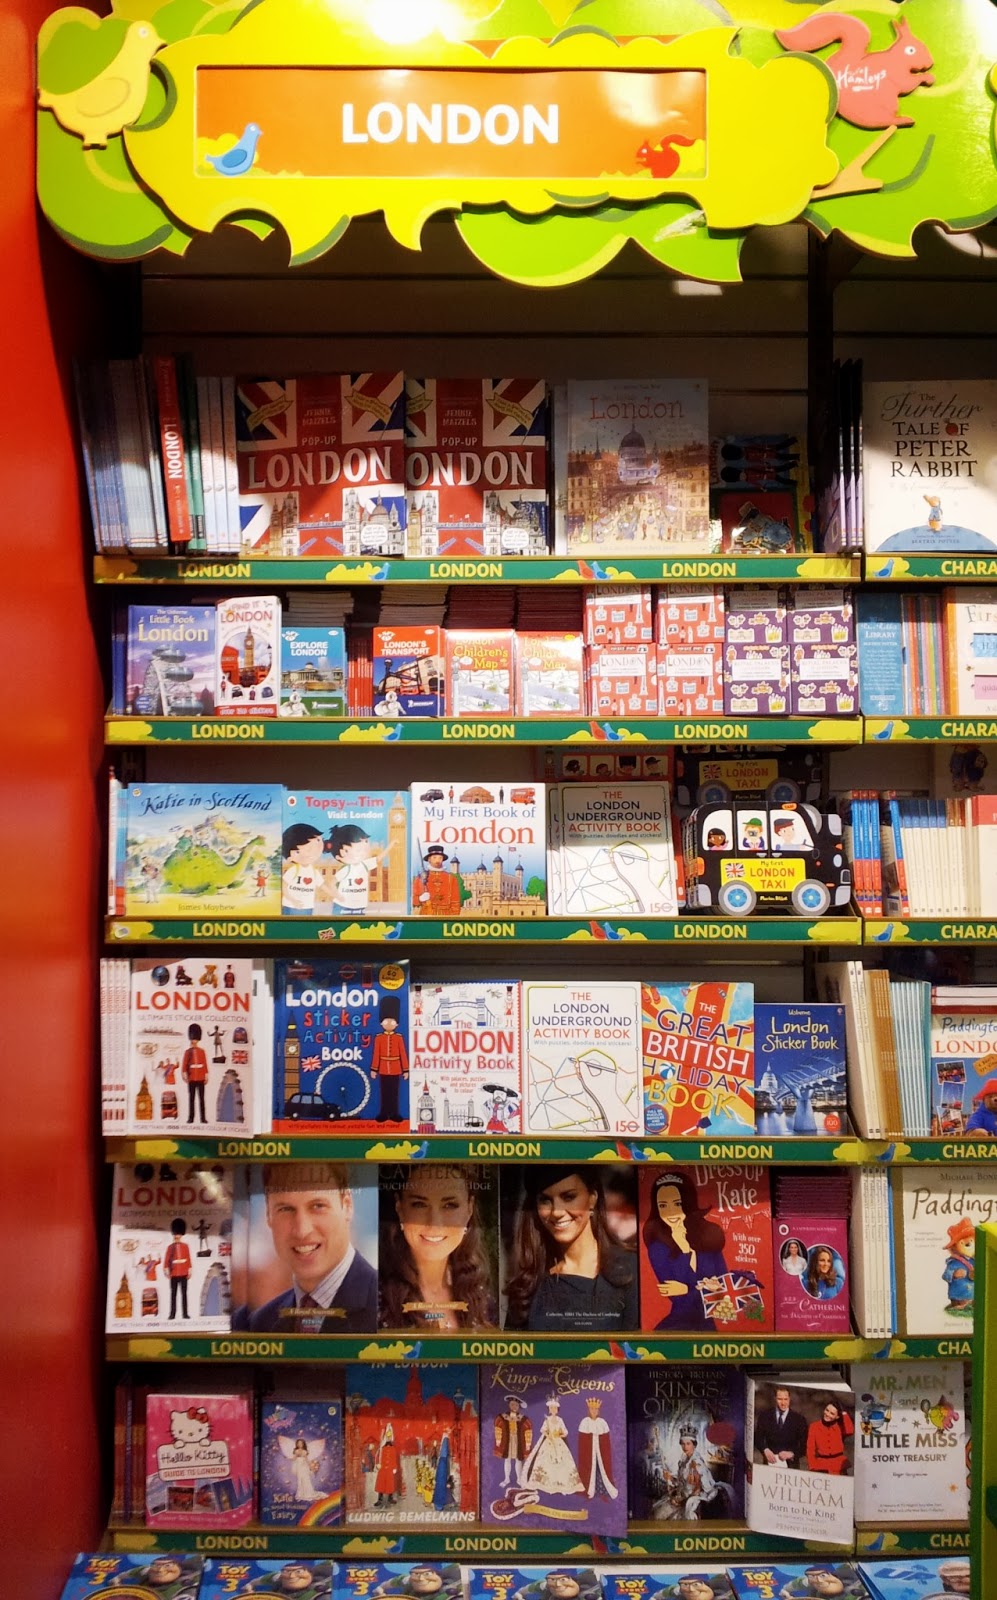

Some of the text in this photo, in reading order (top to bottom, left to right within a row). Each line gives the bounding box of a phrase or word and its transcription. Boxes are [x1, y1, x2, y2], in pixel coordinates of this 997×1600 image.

[837, 64, 887, 91] Hamleys
[342, 102, 559, 145] LONDON
[919, 393, 936, 401] The
[590, 395, 685, 420] London
[881, 391, 983, 422] Further
[892, 421, 970, 437] TALE OF
[302, 436, 337, 446] POP-UP
[442, 437, 478, 446] POP-UP
[163, 423, 183, 480] LONDON
[894, 440, 972, 457] PETER
[248, 446, 392, 489] LONDON
[406, 451, 534, 487] ONDON
[891, 460, 978, 478] RABBIT
[178, 563, 251, 578] LONDON
[429, 563, 503, 578] LONDON
[662, 562, 737, 577] LONDON
[149, 615, 195, 624] Little Book
[220, 611, 273, 623] LONDON
[138, 624, 209, 642] London
[864, 631, 896, 639] LIBRARY
[290, 641, 329, 649] EXPLORE
[381, 647, 430, 655] TRANSPORT
[383, 640, 427, 649] LONDON'S
[291, 648, 327, 656] LONDON
[453, 646, 509, 658] Children's
[474, 658, 498, 670] Map
[543, 660, 567, 670] Map
[192, 724, 265, 739] LONDON
[442, 724, 515, 738] LONDON
[674, 724, 748, 739] LONDON
[726, 768, 769, 777] LONDON
[735, 780, 760, 788] TAXI
[602, 791, 623, 799] THE
[141, 791, 273, 817] Katie in Scotland
[305, 795, 384, 810] Topsy Tim
[586, 801, 640, 810] LONDON
[327, 810, 383, 819] Visit London
[424, 806, 537, 821] My First Book of
[566, 812, 662, 821] UNDERGROUND
[424, 819, 535, 845] London
[568, 823, 661, 832] ACTIVITY BOOK
[750, 868, 795, 877] LONDON
[289, 885, 314, 893] LONDON
[760, 880, 787, 889] TAXI
[178, 903, 236, 912] James Mayhew
[193, 922, 266, 937] LONDON
[443, 922, 515, 937] LONDON
[673, 924, 747, 939] LONDON
[136, 991, 250, 1013] LONDON
[286, 982, 378, 1008] London
[571, 992, 592, 1001] THE
[553, 1003, 610, 1013] LONDON
[699, 1001, 718, 1014] THE
[454, 1020, 472, 1029] The
[532, 1016, 632, 1027] UNDERGROUND
[657, 1008, 750, 1047] GREAT
[771, 1016, 829, 1034] London
[303, 1029, 372, 1048] Activity
[533, 1028, 630, 1039] ACTIVITY BOOK
[413, 1030, 514, 1054] LONDON
[762, 1034, 839, 1053] Sticker Book
[646, 1031, 750, 1075] BRITISH
[413, 1054, 515, 1074] Activity Book
[648, 1079, 736, 1119] BOOK
[218, 1142, 291, 1156] LONDON
[469, 1142, 541, 1157] LONDON
[700, 1145, 773, 1159] LONDON
[695, 1165, 743, 1186] Dress
[940, 1173, 973, 1181] MICHAEL
[117, 1186, 219, 1207] LONDO
[716, 1181, 758, 1212] Kate
[732, 1233, 750, 1242] With
[738, 1243, 755, 1255] 350
[734, 1255, 758, 1264] stickers
[800, 1298, 846, 1312] CATHERINE
[211, 1342, 284, 1355] LONDON
[462, 1342, 534, 1356] LONDON
[693, 1343, 765, 1357] LONDON
[489, 1364, 616, 1395] Kings Queens
[869, 1375, 946, 1391] MR. MEN
[655, 1381, 719, 1398] KINGS
[899, 1396, 919, 1406] and
[861, 1432, 958, 1449] LITTLE MISS
[161, 1450, 226, 1464] Hello Kitty
[872, 1453, 947, 1463] STORY TREASURY
[197, 1467, 227, 1475] LONDON
[775, 1473, 832, 1491] PRINCE
[273, 1493, 294, 1503] Kate
[761, 1484, 844, 1508] WILLIAM
[271, 1511, 297, 1521] Fairy
[348, 1511, 476, 1523] LUDWIG BEMELMANS
[769, 1503, 789, 1513] Born
[802, 1507, 812, 1516] be
[815, 1509, 836, 1520] King
[196, 1536, 269, 1550] LONDON
[445, 1537, 517, 1551] LONDON
[674, 1537, 746, 1551] LONDON
[88, 1559, 119, 1570] TOY
[218, 1565, 251, 1575] TOY
[94, 1571, 105, 1585] 3
[347, 1568, 379, 1579] TOY
[482, 1574, 514, 1584] TOY
[742, 1570, 774, 1582] TOY
[227, 1578, 239, 1593] 3
[355, 1580, 369, 1596] 3
[615, 1579, 645, 1589] TOY
[758, 1583, 774, 1599] 3
[493, 1586, 507, 1600] 3
